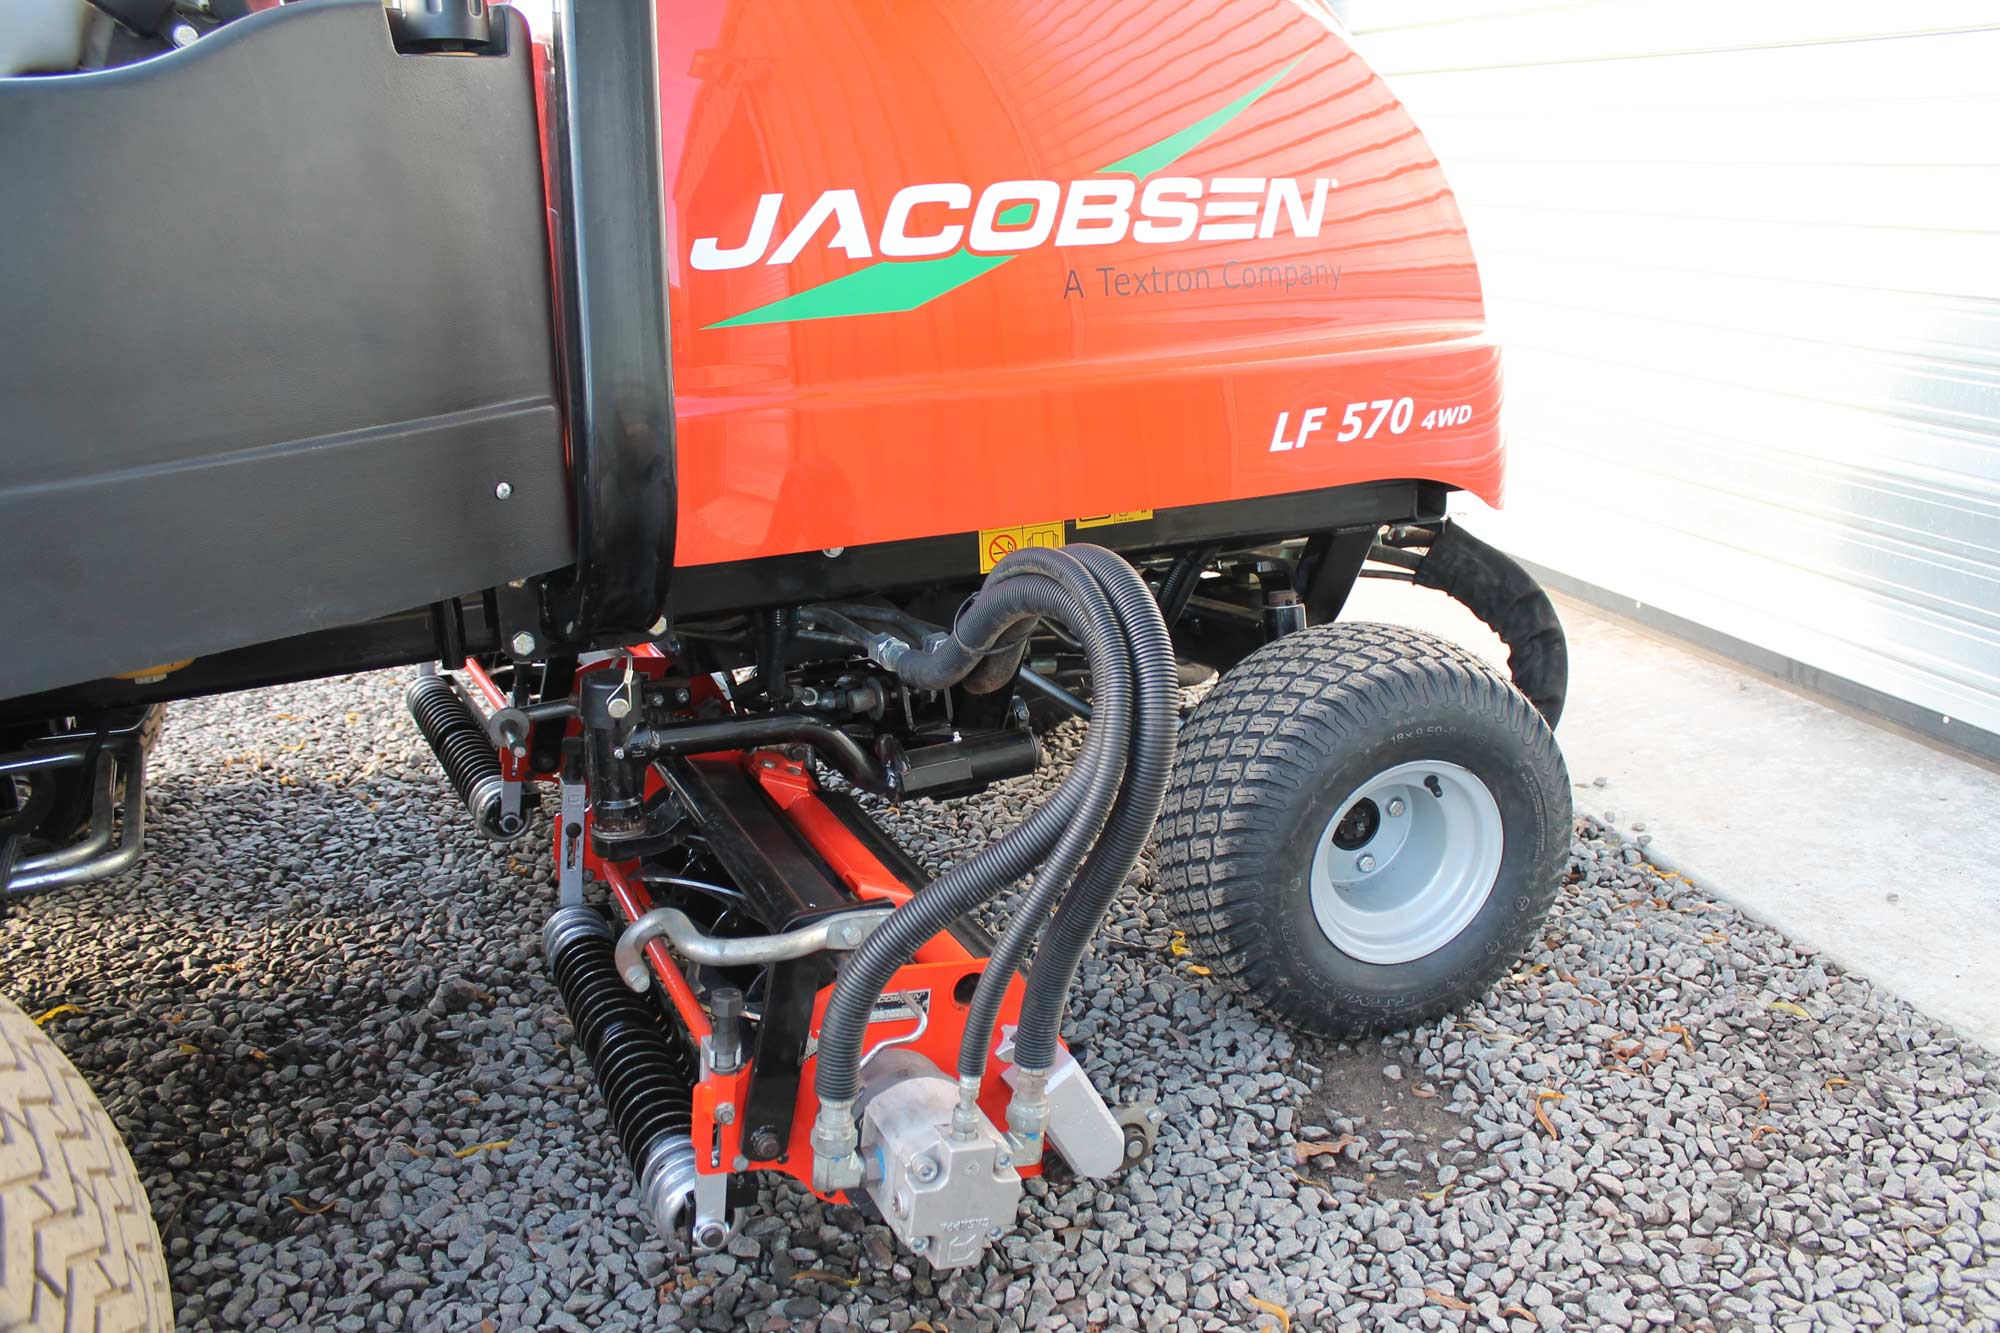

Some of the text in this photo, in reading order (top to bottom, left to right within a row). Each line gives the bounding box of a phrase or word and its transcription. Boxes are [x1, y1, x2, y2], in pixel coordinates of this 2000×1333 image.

[690, 177, 1329, 270] JACOBSEN
[1063, 260, 1342, 299] A Textron Company
[1269, 396, 1473, 453] LF 570 4WD
